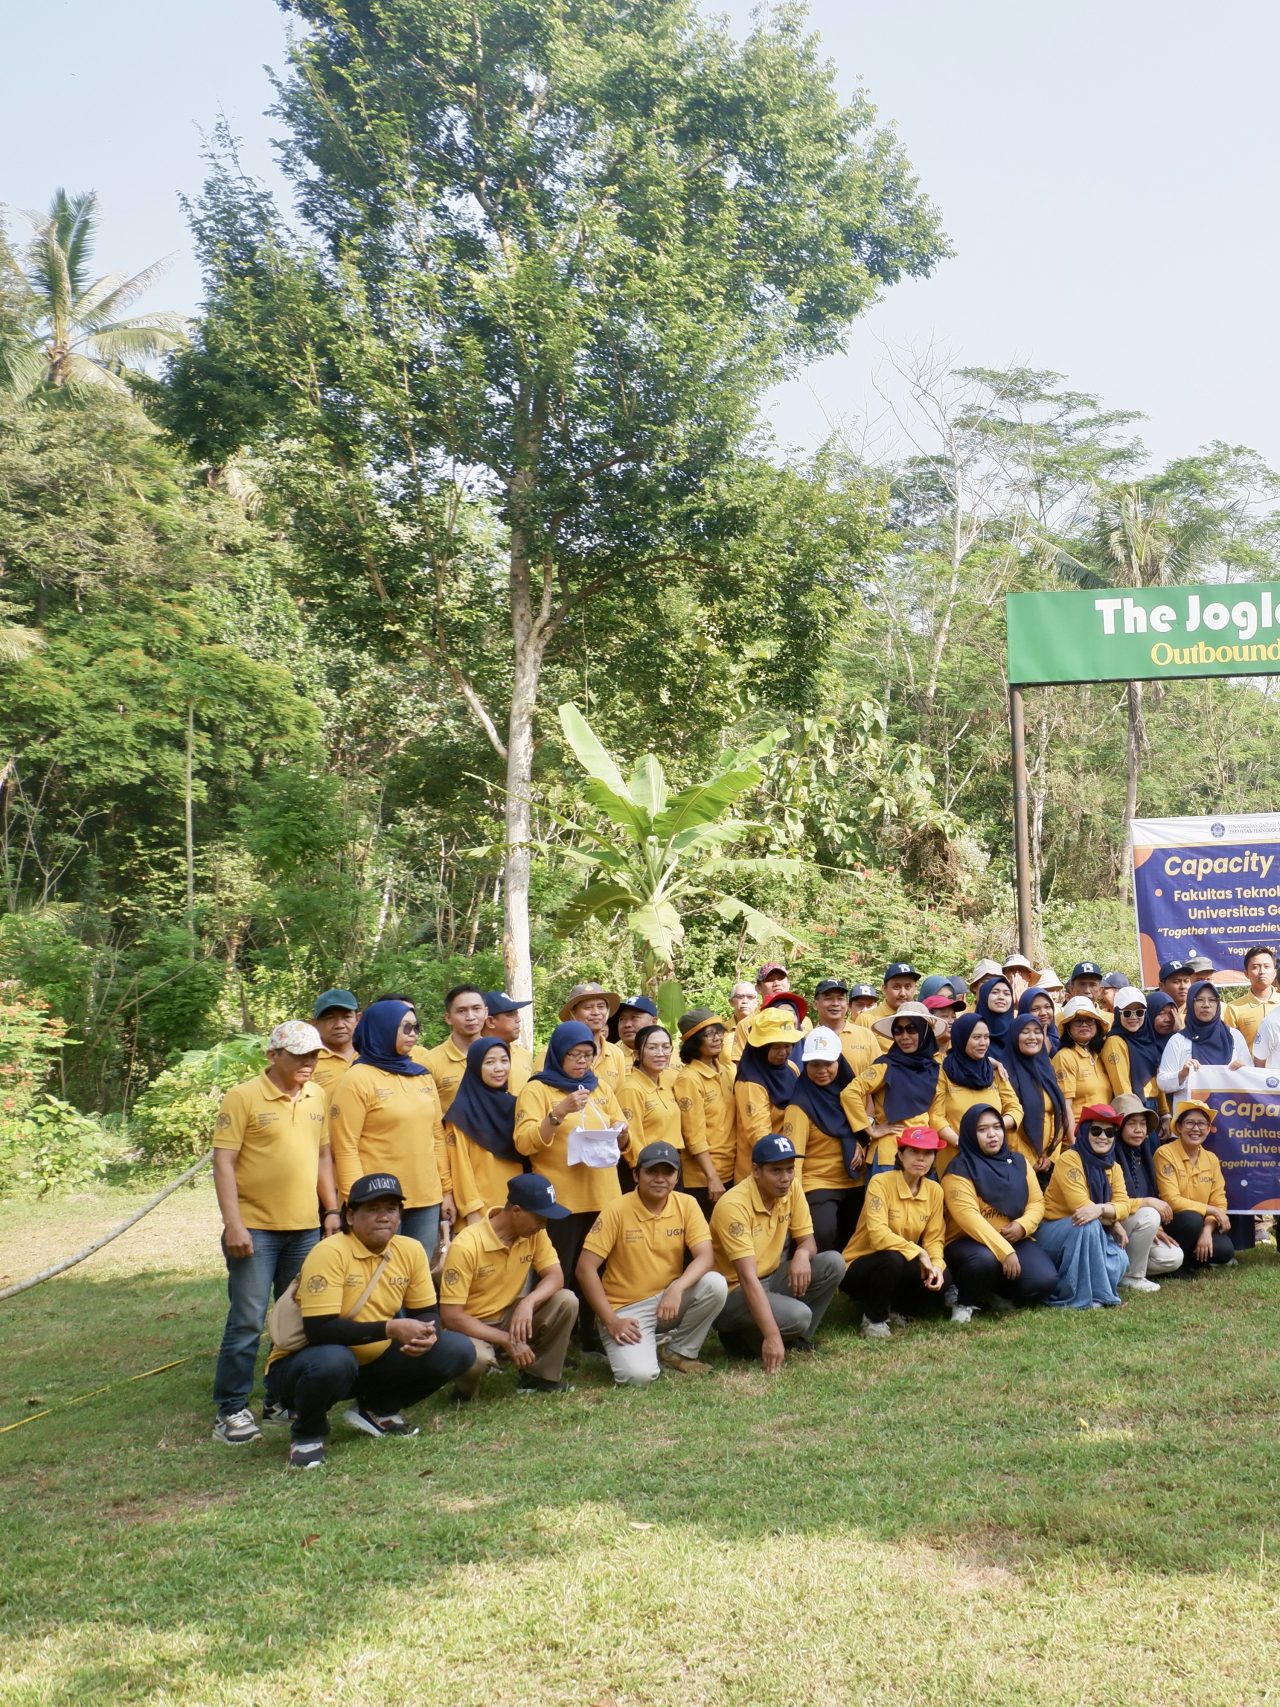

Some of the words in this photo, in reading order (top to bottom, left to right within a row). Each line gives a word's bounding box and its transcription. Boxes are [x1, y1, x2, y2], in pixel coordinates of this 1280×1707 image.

[1094, 597, 1177, 635] The
[1164, 850, 1275, 881] Capacity
[1173, 887, 1233, 902] Fakultas
[1188, 904, 1265, 920] Universitas
[1157, 926, 1209, 939] “Together
[1210, 926, 1225, 935] we
[1226, 926, 1247, 934] can
